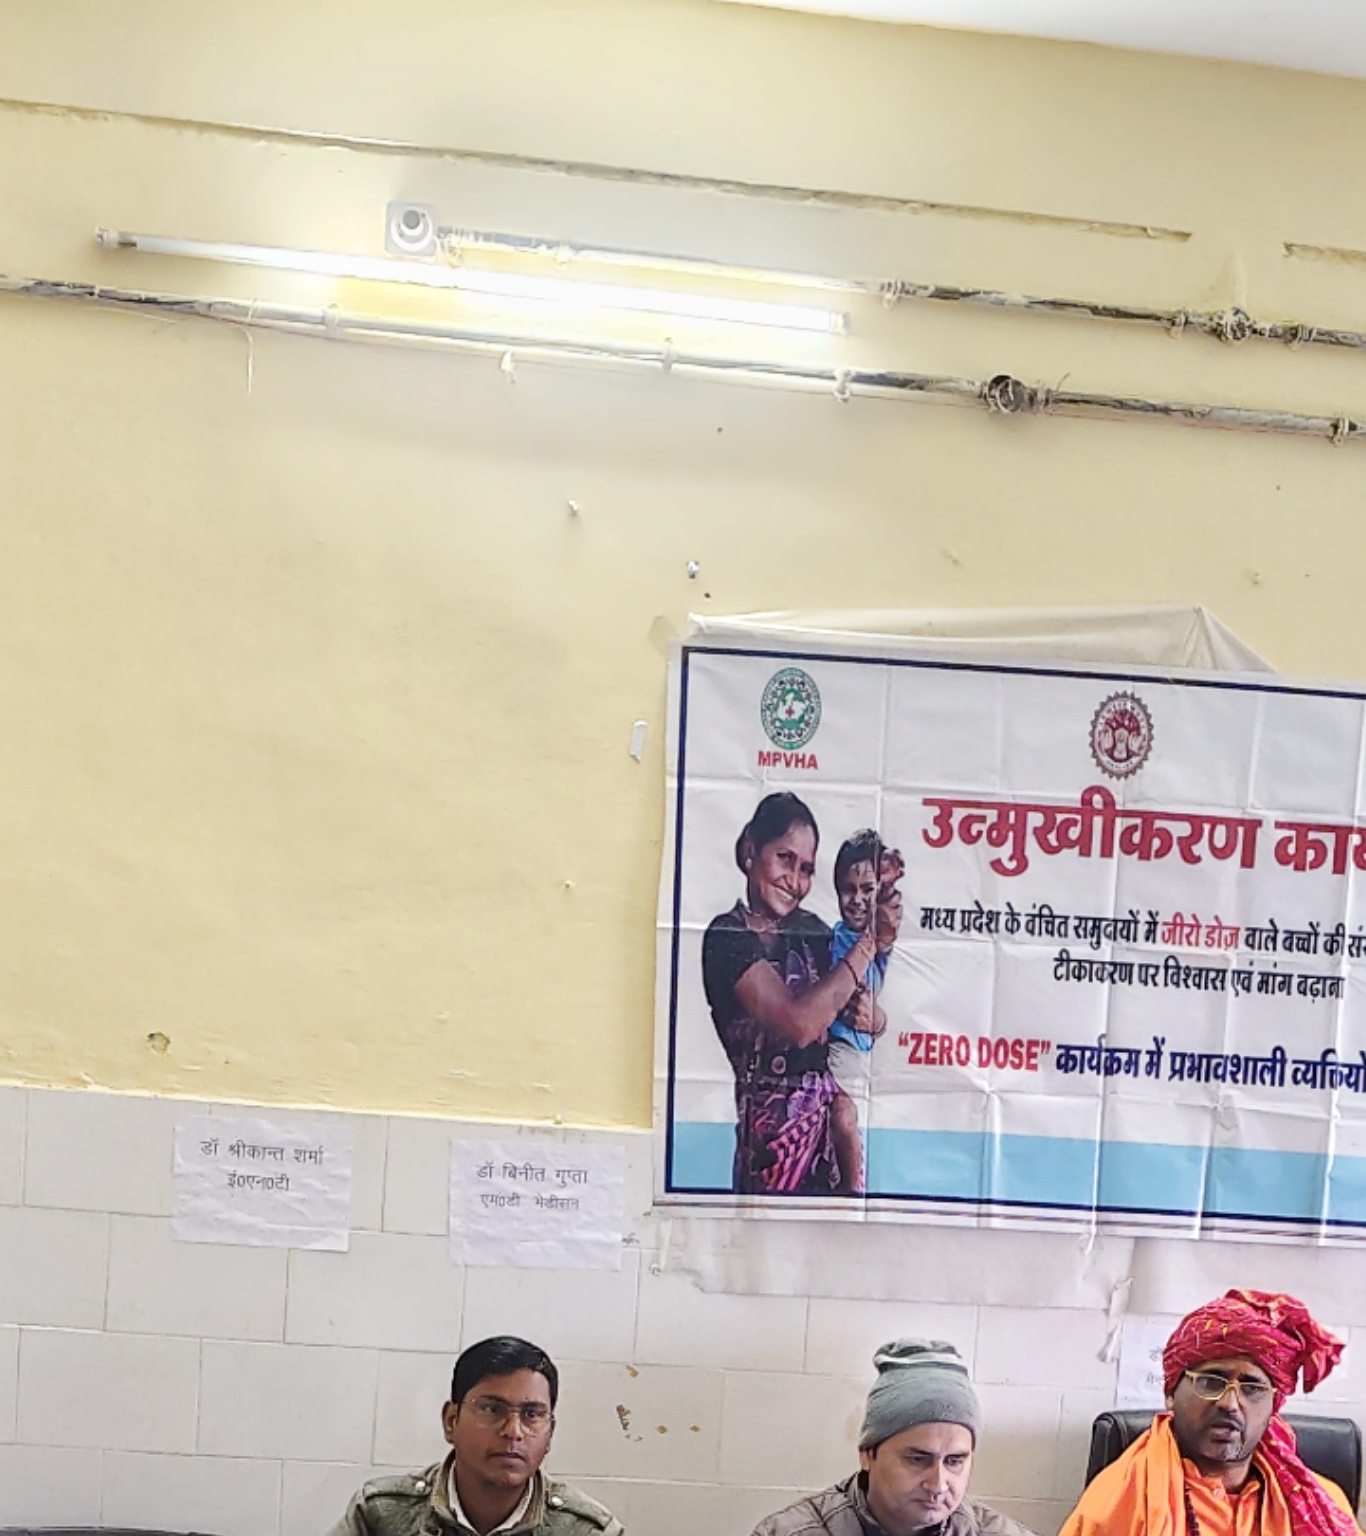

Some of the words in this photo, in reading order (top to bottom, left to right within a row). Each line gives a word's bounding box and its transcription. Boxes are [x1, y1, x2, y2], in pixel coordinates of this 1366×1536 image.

[757, 750, 818, 769] MPVHA
[922, 785, 1262, 877] उन्मुखीकरण
[920, 905, 956, 931] मध्य
[960, 900, 1001, 934] प्रदेश
[1005, 902, 1021, 934] के
[1025, 903, 1070, 938] वंचित
[1073, 910, 1140, 950] समुदायों
[1144, 911, 1160, 944] में
[1162, 911, 1202, 947] जीरो
[1244, 918, 1278, 952] वाले
[1283, 921, 1321, 955] बच्चों
[1323, 923, 1345, 956] की
[1054, 948, 1134, 986] टीकाकरण
[1138, 961, 1161, 987] पर
[1164, 955, 1226, 991] विश्वास
[1231, 960, 1255, 998] एवं
[1257, 963, 1293, 996] मांग
[1297, 973, 1346, 1003] बढ़ाना
[1056, 1033, 1142, 1078] कार्यक्रम
[1145, 1036, 1167, 1079] में
[1168, 1046, 1288, 1087] प्रभावशाली
[200, 1138, 219, 1156] डॉ
[228, 1139, 284, 1162] श्रीकान्त
[293, 1145, 326, 1165] शर्मा
[555, 1168, 588, 1188] गुप्ता
